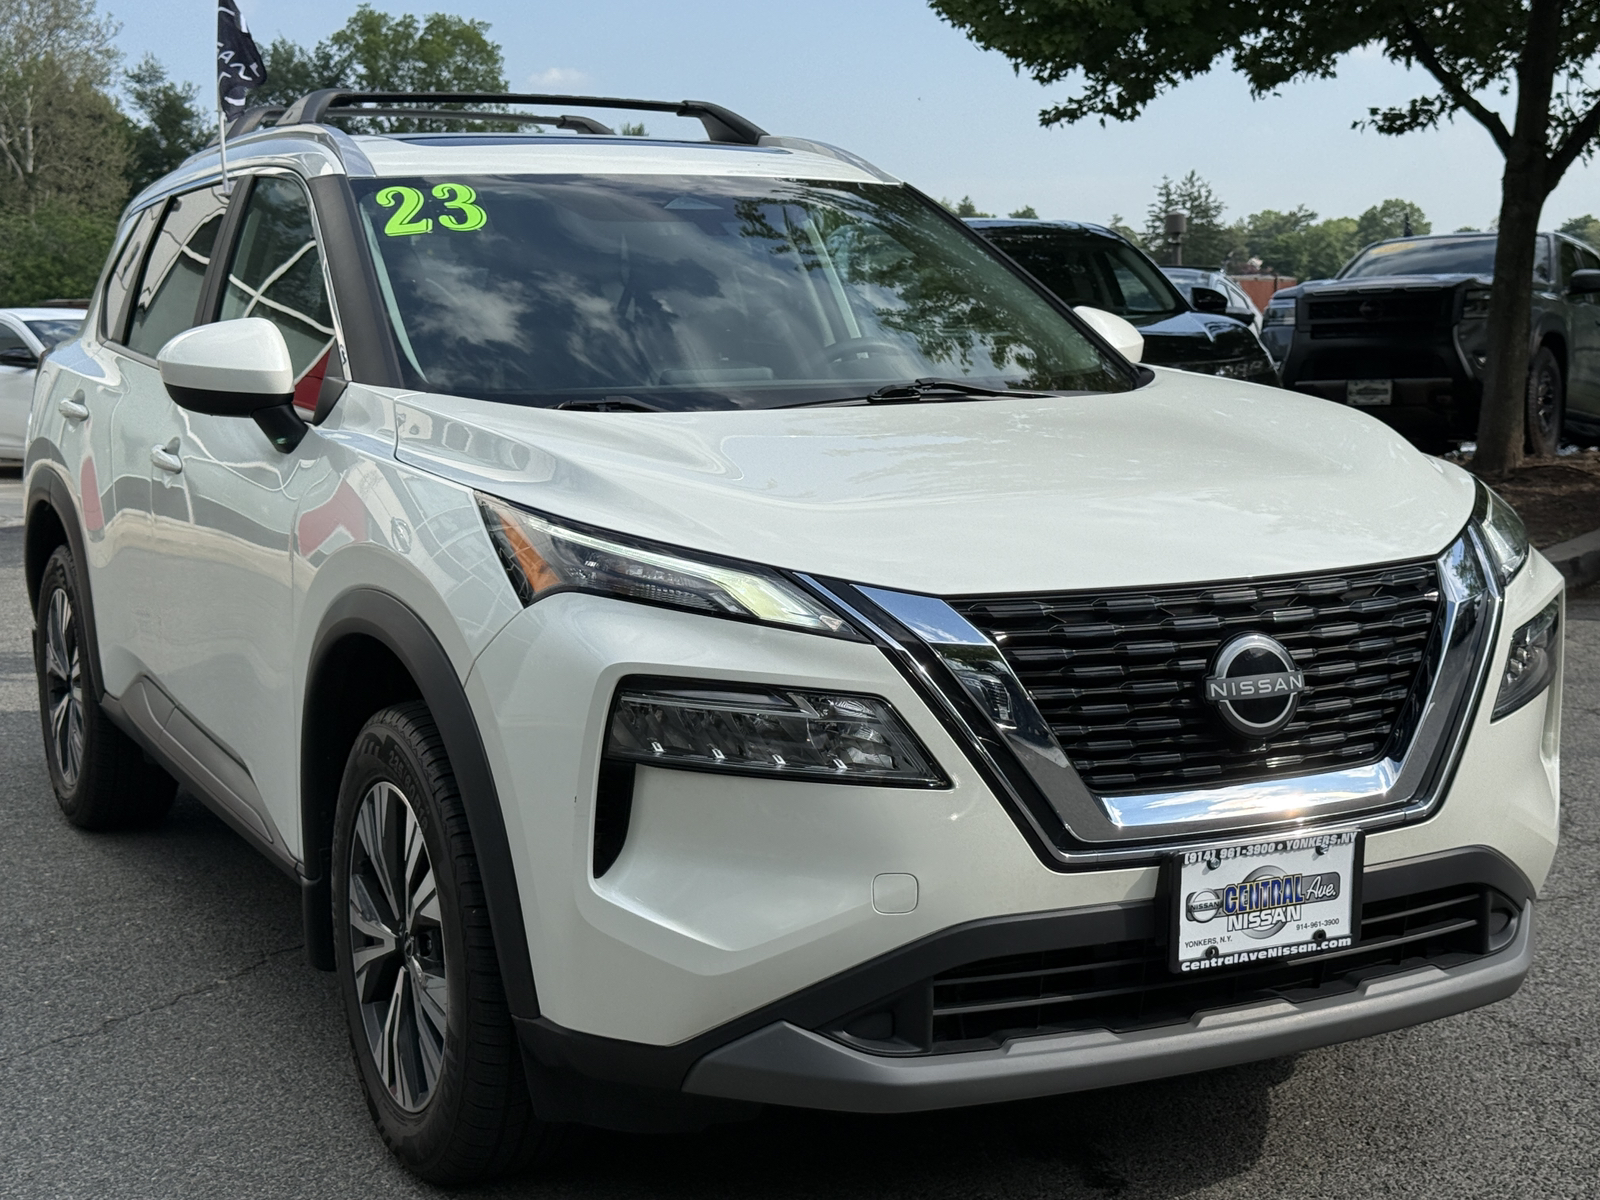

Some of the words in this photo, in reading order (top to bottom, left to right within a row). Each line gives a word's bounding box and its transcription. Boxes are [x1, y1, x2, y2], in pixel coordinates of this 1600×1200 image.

[375, 183, 487, 237] 23
[1210, 674, 1303, 697] NISSAN
[1190, 900, 1221, 911] NISSAN
[1223, 873, 1305, 915] CENTRAL
[1306, 875, 1337, 900] Ave.
[1227, 904, 1302, 932] NISSAN
[1295, 917, 1340, 931] 914-961-3900
[1184, 937, 1219, 949] YONKERS,
